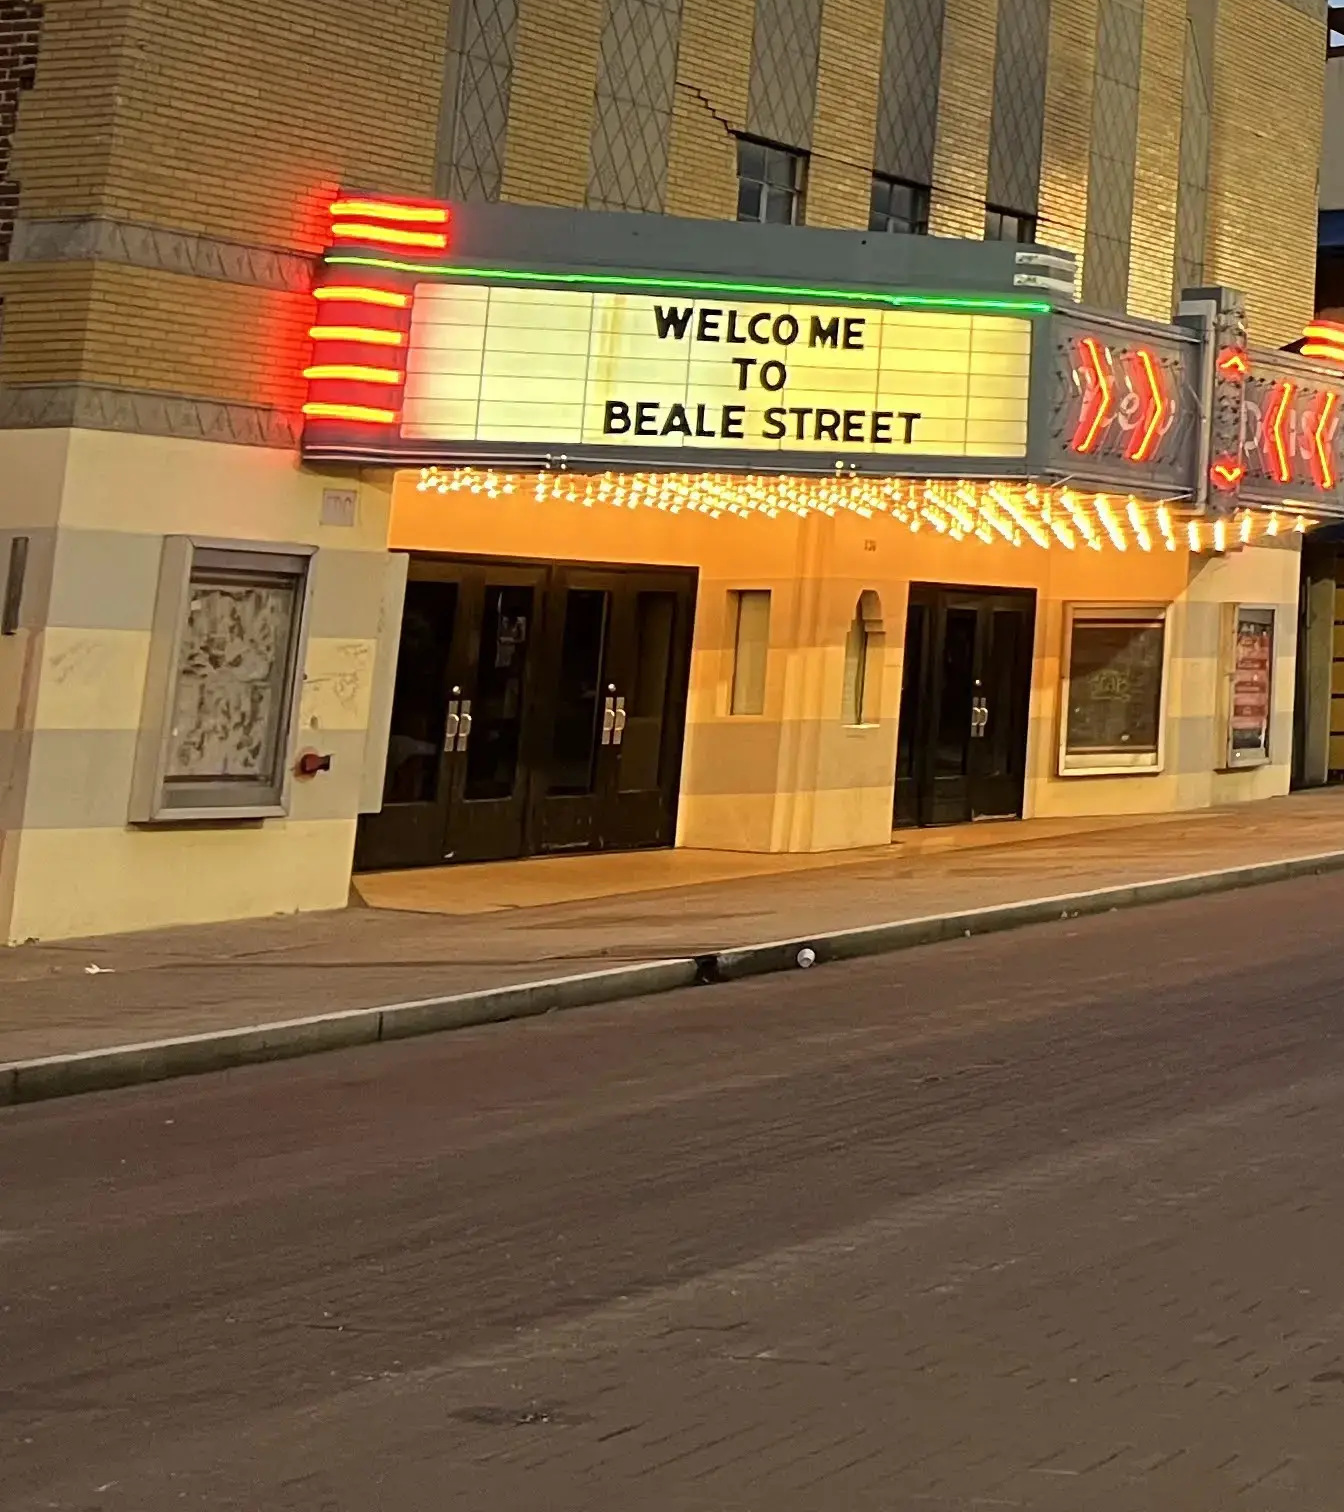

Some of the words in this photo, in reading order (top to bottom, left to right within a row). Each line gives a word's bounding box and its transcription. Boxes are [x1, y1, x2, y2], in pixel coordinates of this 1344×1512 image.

[653, 305, 866, 350] WELCOME
[731, 357, 787, 392] TO
[602, 400, 746, 438] BEALE
[761, 406, 922, 445] STREET
